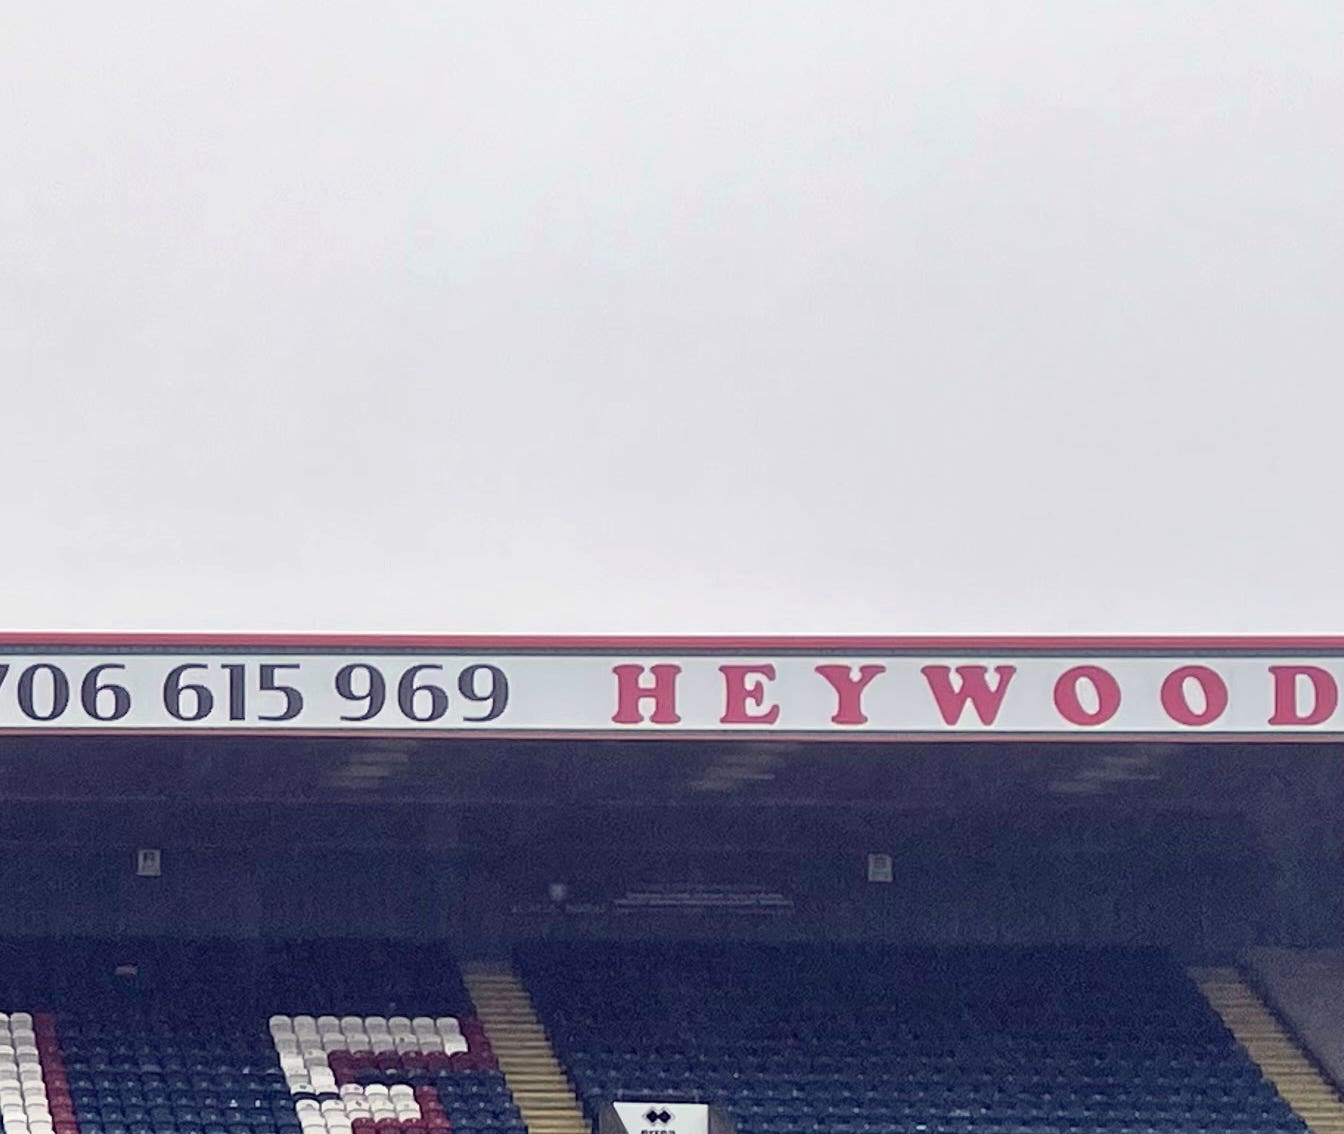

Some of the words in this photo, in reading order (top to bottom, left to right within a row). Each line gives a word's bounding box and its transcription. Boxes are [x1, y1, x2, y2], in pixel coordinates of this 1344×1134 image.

[162, 663, 305, 722] 615
[334, 664, 510, 723] 969
[611, 664, 1340, 728] HEYWOOD
